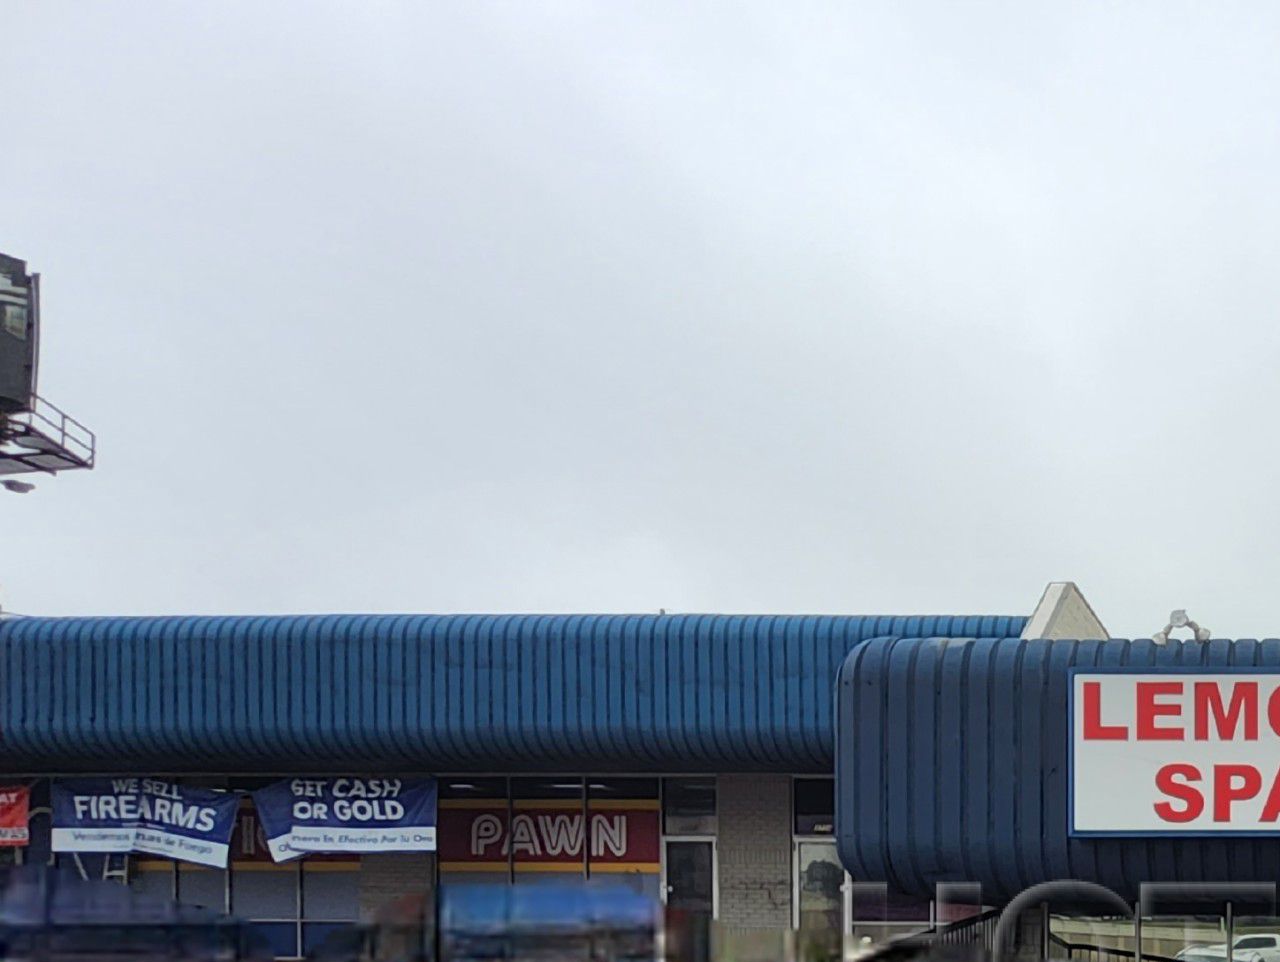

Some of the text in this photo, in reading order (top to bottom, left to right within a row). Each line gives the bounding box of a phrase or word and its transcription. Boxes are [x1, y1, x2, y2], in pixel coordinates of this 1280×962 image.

[112, 778, 183, 800] WE SELL
[332, 778, 403, 798] CASH
[74, 795, 218, 832] FIREARMS
[334, 799, 405, 821] GOLD
[471, 813, 627, 857] PAWN
